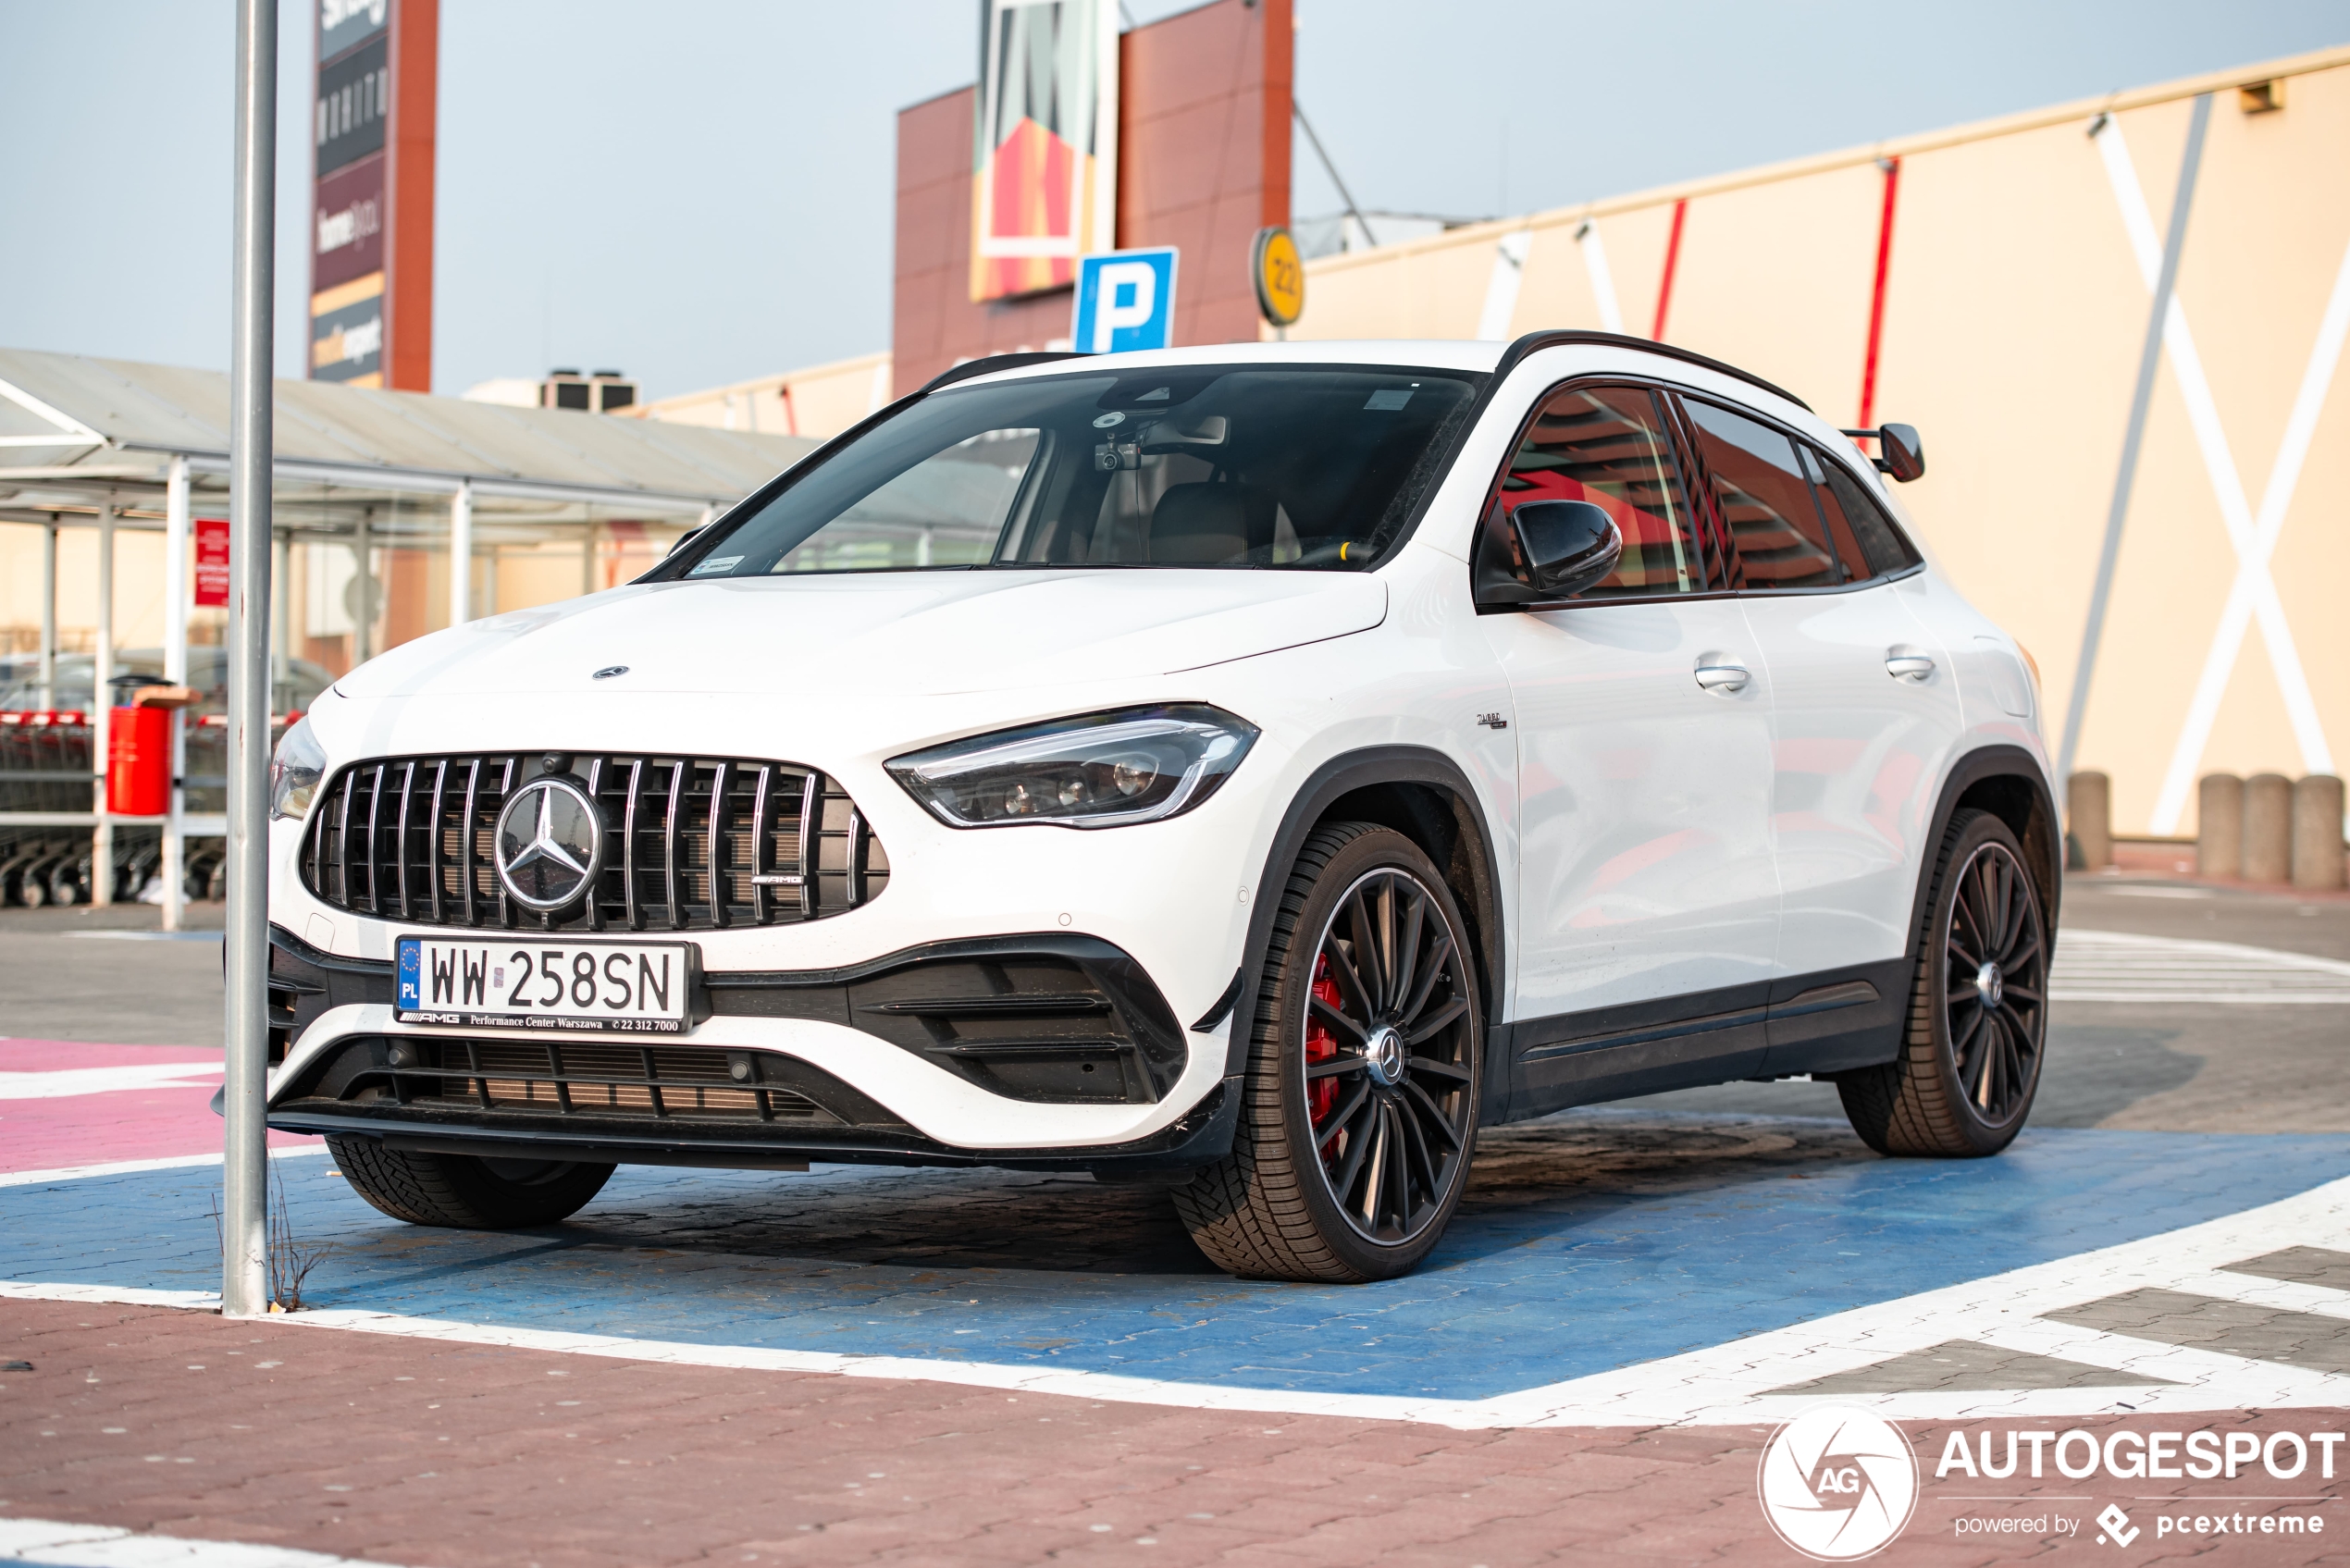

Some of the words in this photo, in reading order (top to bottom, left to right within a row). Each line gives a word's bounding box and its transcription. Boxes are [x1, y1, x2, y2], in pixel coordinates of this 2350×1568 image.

[1273, 257, 1297, 297] 22
[1092, 261, 1156, 353] P
[768, 875, 802, 883] AMG
[402, 983, 417, 998] PL
[431, 947, 488, 1006] WW
[508, 951, 669, 1011] 258SN
[417, 1013, 460, 1023] AMG
[470, 1015, 524, 1027] Performance
[526, 1017, 555, 1028] Center
[557, 1018, 602, 1029] Warszawa
[621, 1019, 632, 1031] 22
[636, 1020, 651, 1031] 312
[654, 1020, 678, 1031] 7000
